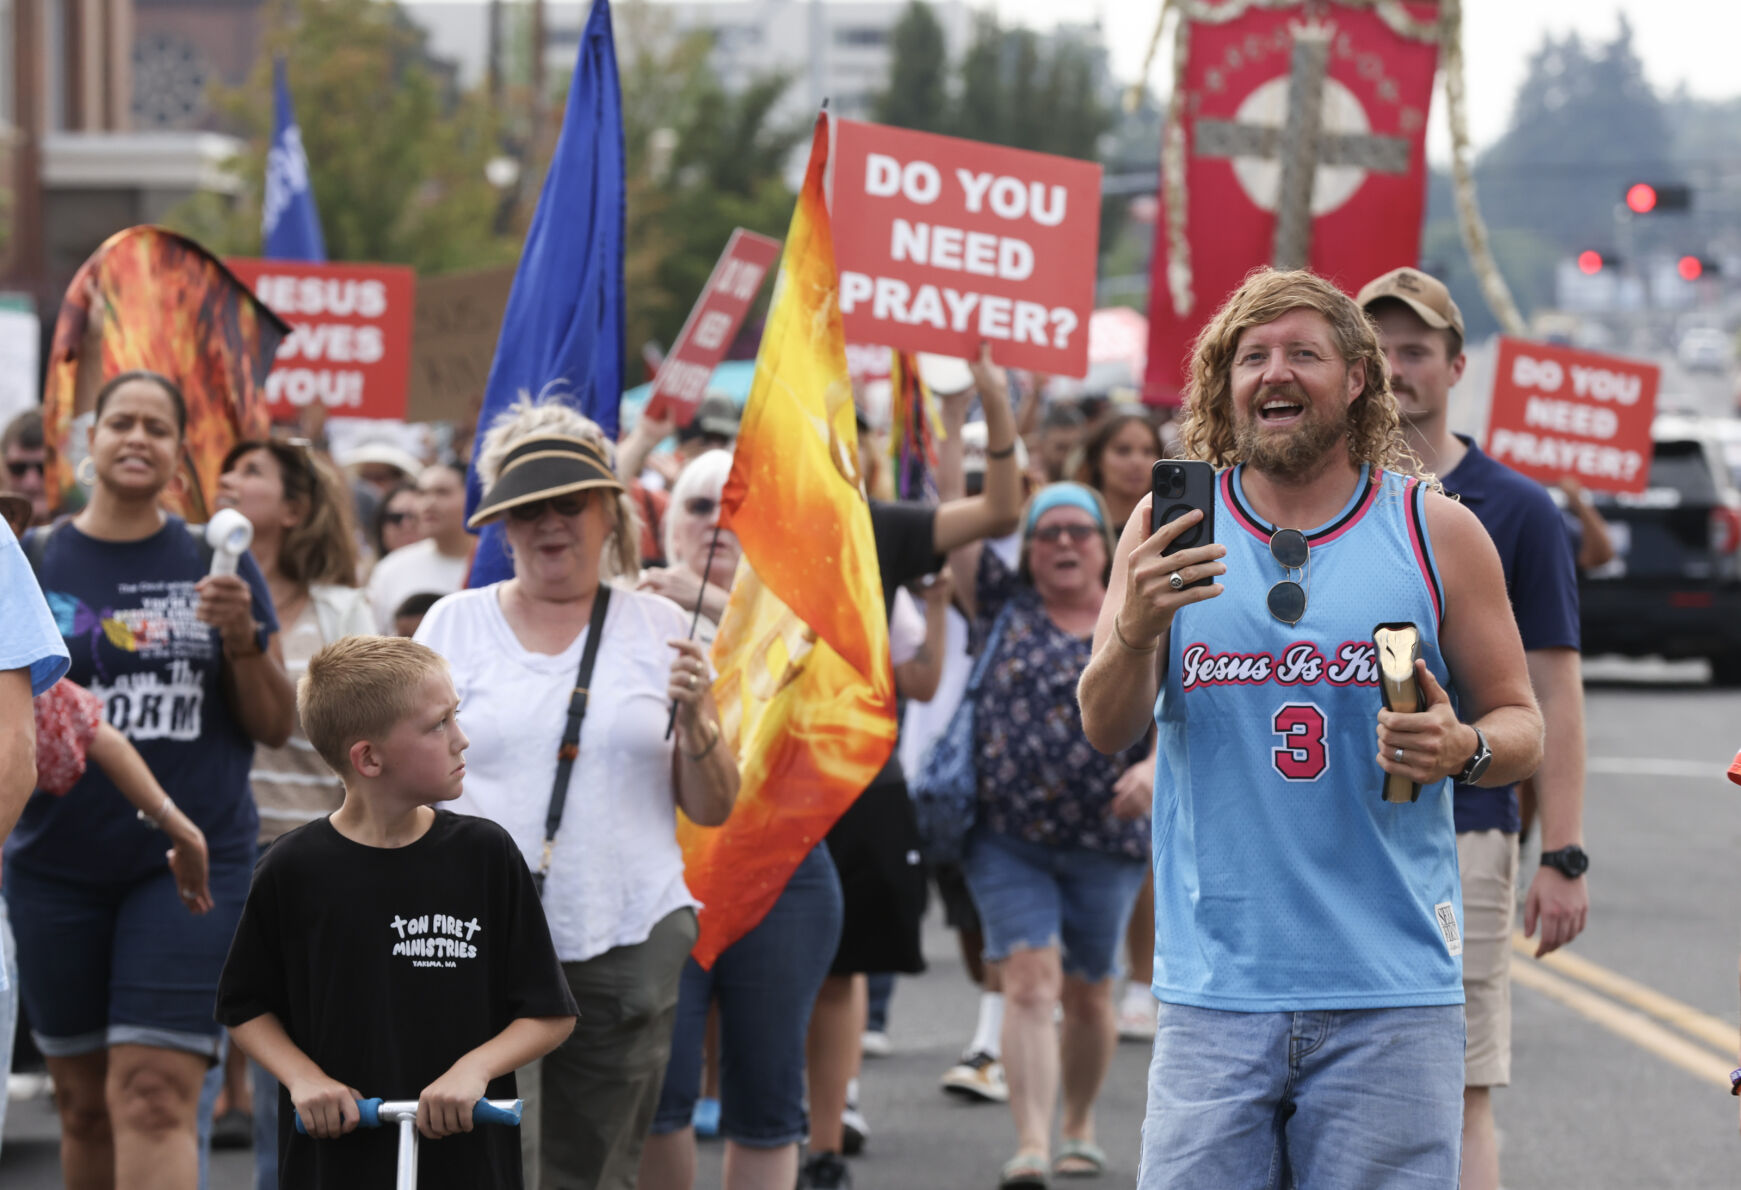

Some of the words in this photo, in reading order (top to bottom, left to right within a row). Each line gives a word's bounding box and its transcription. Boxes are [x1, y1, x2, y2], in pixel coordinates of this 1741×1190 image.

[865, 153, 942, 204] DO
[956, 169, 1067, 226] YOU
[891, 219, 1035, 280] NEED
[840, 271, 1078, 349] PRAYER?
[275, 322, 384, 363] OVES
[264, 367, 364, 407] YOU!
[1512, 355, 1563, 392] DO
[1570, 365, 1642, 405] YOU
[1525, 396, 1618, 439] NEED
[1491, 428, 1642, 482] PRAYER?
[1183, 643, 1273, 690] Jesus
[1276, 642, 1325, 685] Is
[1271, 701, 1330, 782] 3
[392, 937, 478, 959] MINISTRIES
[407, 914, 429, 935] ON
[432, 914, 464, 938] FIRE
[412, 960, 444, 968] YAKIMA,
